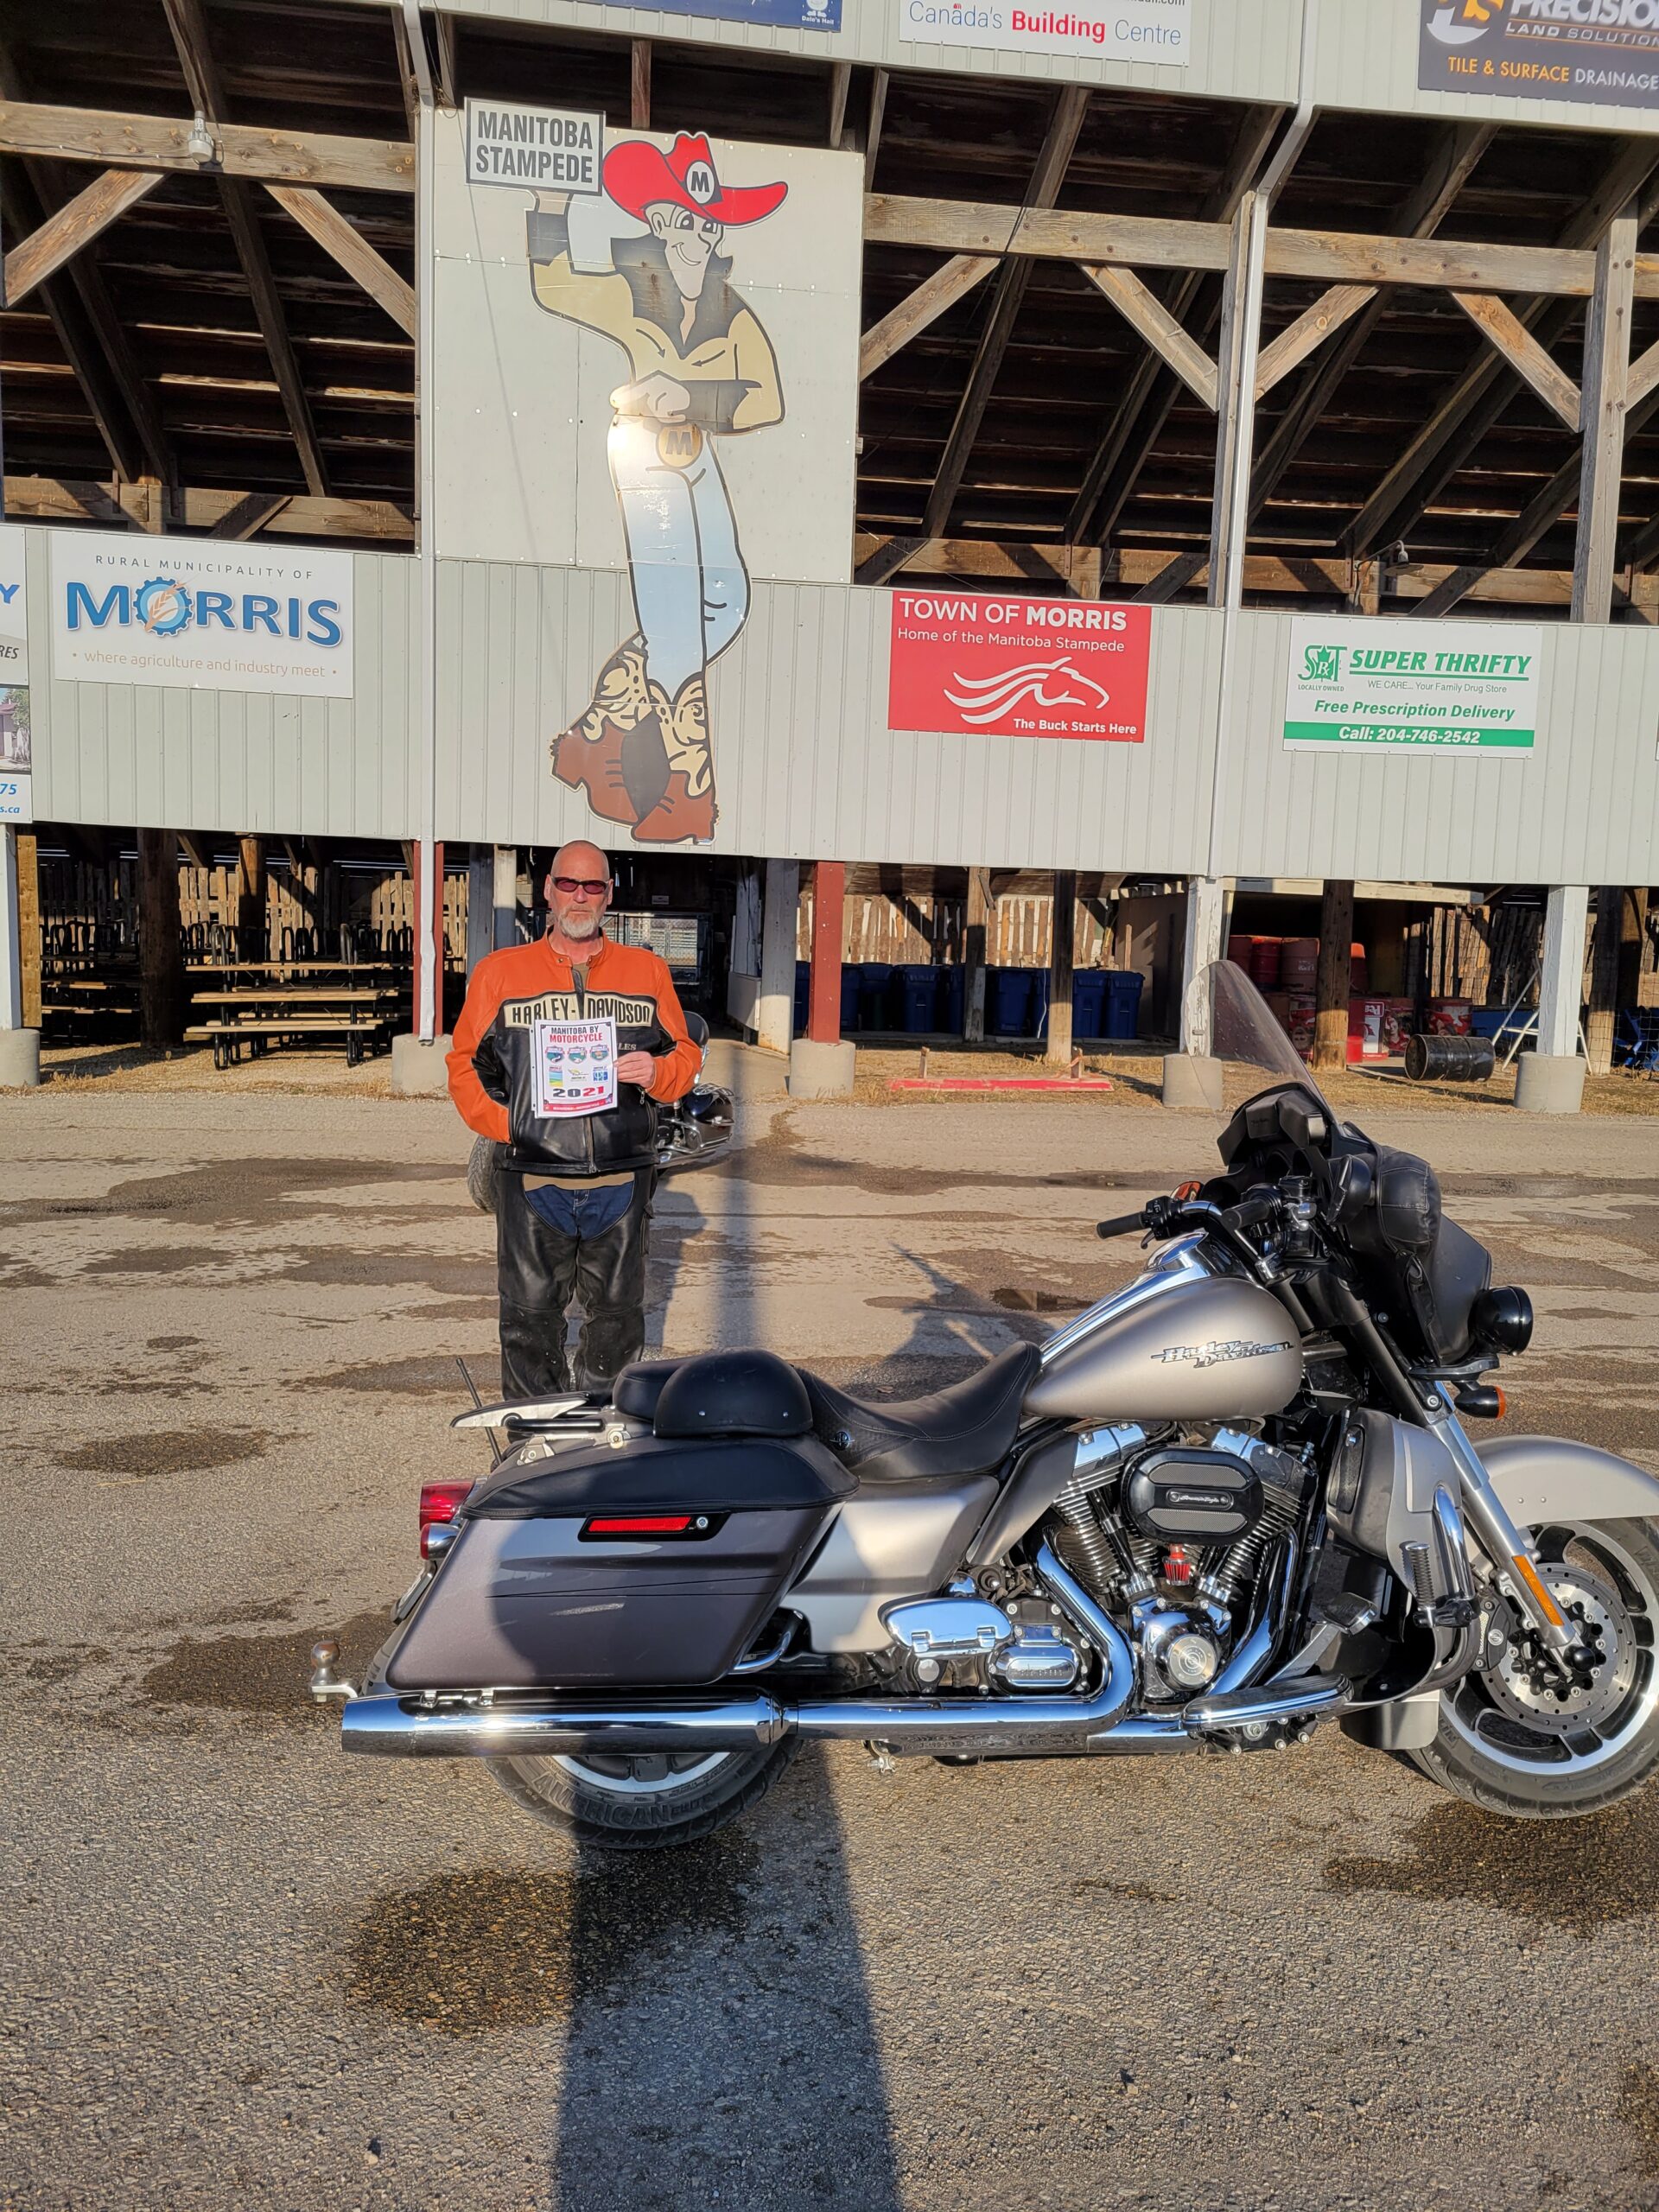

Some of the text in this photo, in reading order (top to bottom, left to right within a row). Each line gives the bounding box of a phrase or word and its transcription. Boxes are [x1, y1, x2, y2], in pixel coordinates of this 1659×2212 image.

[909, 1, 1181, 45] Canada's Building Centre
[1506, 22, 1560, 36] LAND
[1448, 56, 1659, 90] TILE & SURFACE DRAINAGE
[477, 110, 593, 149] MANITOBA
[476, 144, 593, 184] STAMPEDE
[690, 171, 710, 194] M
[666, 430, 693, 456] M
[95, 555, 314, 580] RURAL MUNICIPALITY OF
[65, 575, 344, 648] MORRIS
[899, 598, 1127, 631] TOWN OF MORRIS
[898, 627, 1125, 653] Home of the Manitoba Stampede
[85, 651, 326, 677] where agriculture and industry meet
[1349, 649, 1532, 675] SUPER THRIFTY
[1368, 679, 1382, 689] WE
[1415, 682, 1433, 691] Your
[1435, 683, 1462, 694] Family
[1465, 683, 1484, 695] Drug
[1485, 684, 1507, 694] Store
[1314, 700, 1516, 722] Free Prescription Delivery
[1014, 718, 1137, 734] The Buck Starts Here
[1338, 726, 1481, 745] Call: 204-746-2542
[587, 997, 651, 1023] DAVIDSON
[550, 1027, 588, 1035] MANITOBA
[550, 1033, 603, 1044] MOTORCYCLE
[553, 1086, 604, 1098] 2021
